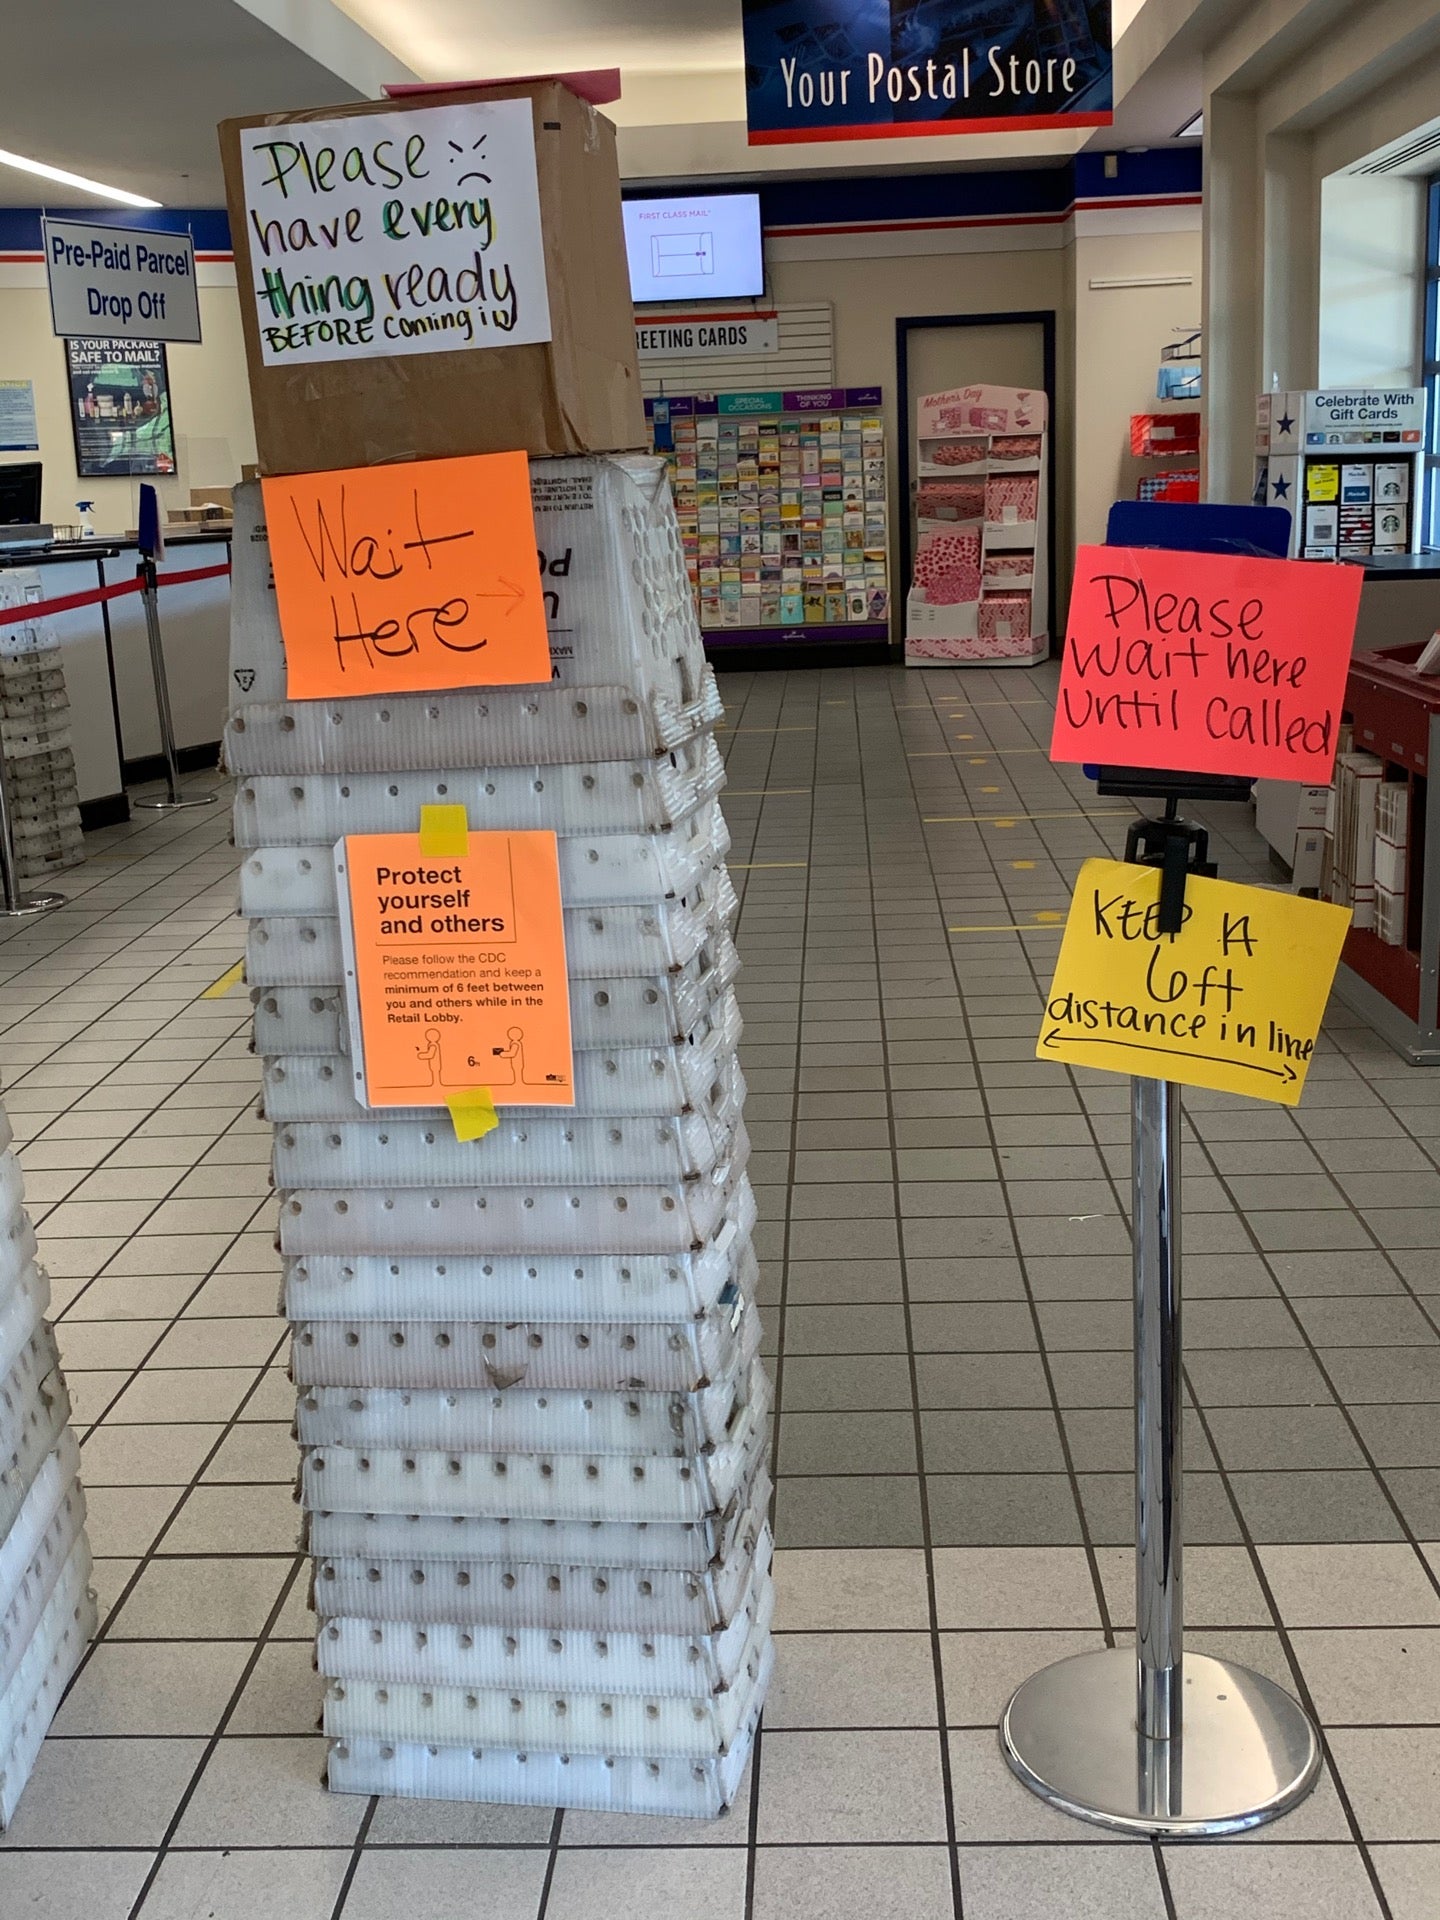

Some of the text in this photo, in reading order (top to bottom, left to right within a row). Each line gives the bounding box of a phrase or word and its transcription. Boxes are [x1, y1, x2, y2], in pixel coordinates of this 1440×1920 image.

[780, 46, 1076, 108] Your Postal Store
[252, 134, 430, 199] Please
[639, 212, 661, 220] FIRST
[662, 211, 687, 219] CLASS
[250, 197, 497, 256] have every
[52, 236, 190, 276] Pre-Paid Parcel
[257, 250, 518, 332] thing ready
[87, 288, 166, 324] Drop Off
[70, 340, 160, 350] IS YOUR PACKAGE
[262, 318, 374, 353] BEFORE
[698, 326, 748, 347] CARDS
[71, 350, 160, 363] SAFE TO MAIL?
[734, 397, 765, 405] SPECIAL
[796, 393, 832, 402] THINKING
[813, 400, 830, 408] YOU
[963, 388, 983, 403] Day
[1315, 394, 1414, 408] Celebrate With
[728, 403, 772, 412] OCCASIONS
[1330, 407, 1398, 421] Gift Cards
[290, 484, 474, 583] Wait
[1090, 574, 1264, 641] Please
[330, 591, 487, 672] Here
[1226, 642, 1307, 688] here
[1063, 688, 1178, 731] Until
[376, 866, 462, 886] Protect
[377, 889, 471, 914] yourself
[380, 914, 505, 934] and others
[1094, 889, 1259, 957] KEEP A
[382, 952, 506, 965] Please follow the CDC
[383, 967, 542, 980] recommendation and keep a
[384, 982, 544, 994] minimum of 6 feet between
[386, 996, 544, 1011] you and others while in the
[387, 1012, 464, 1024] Retail Lobby.
[1048, 992, 1314, 1062] distance in line
